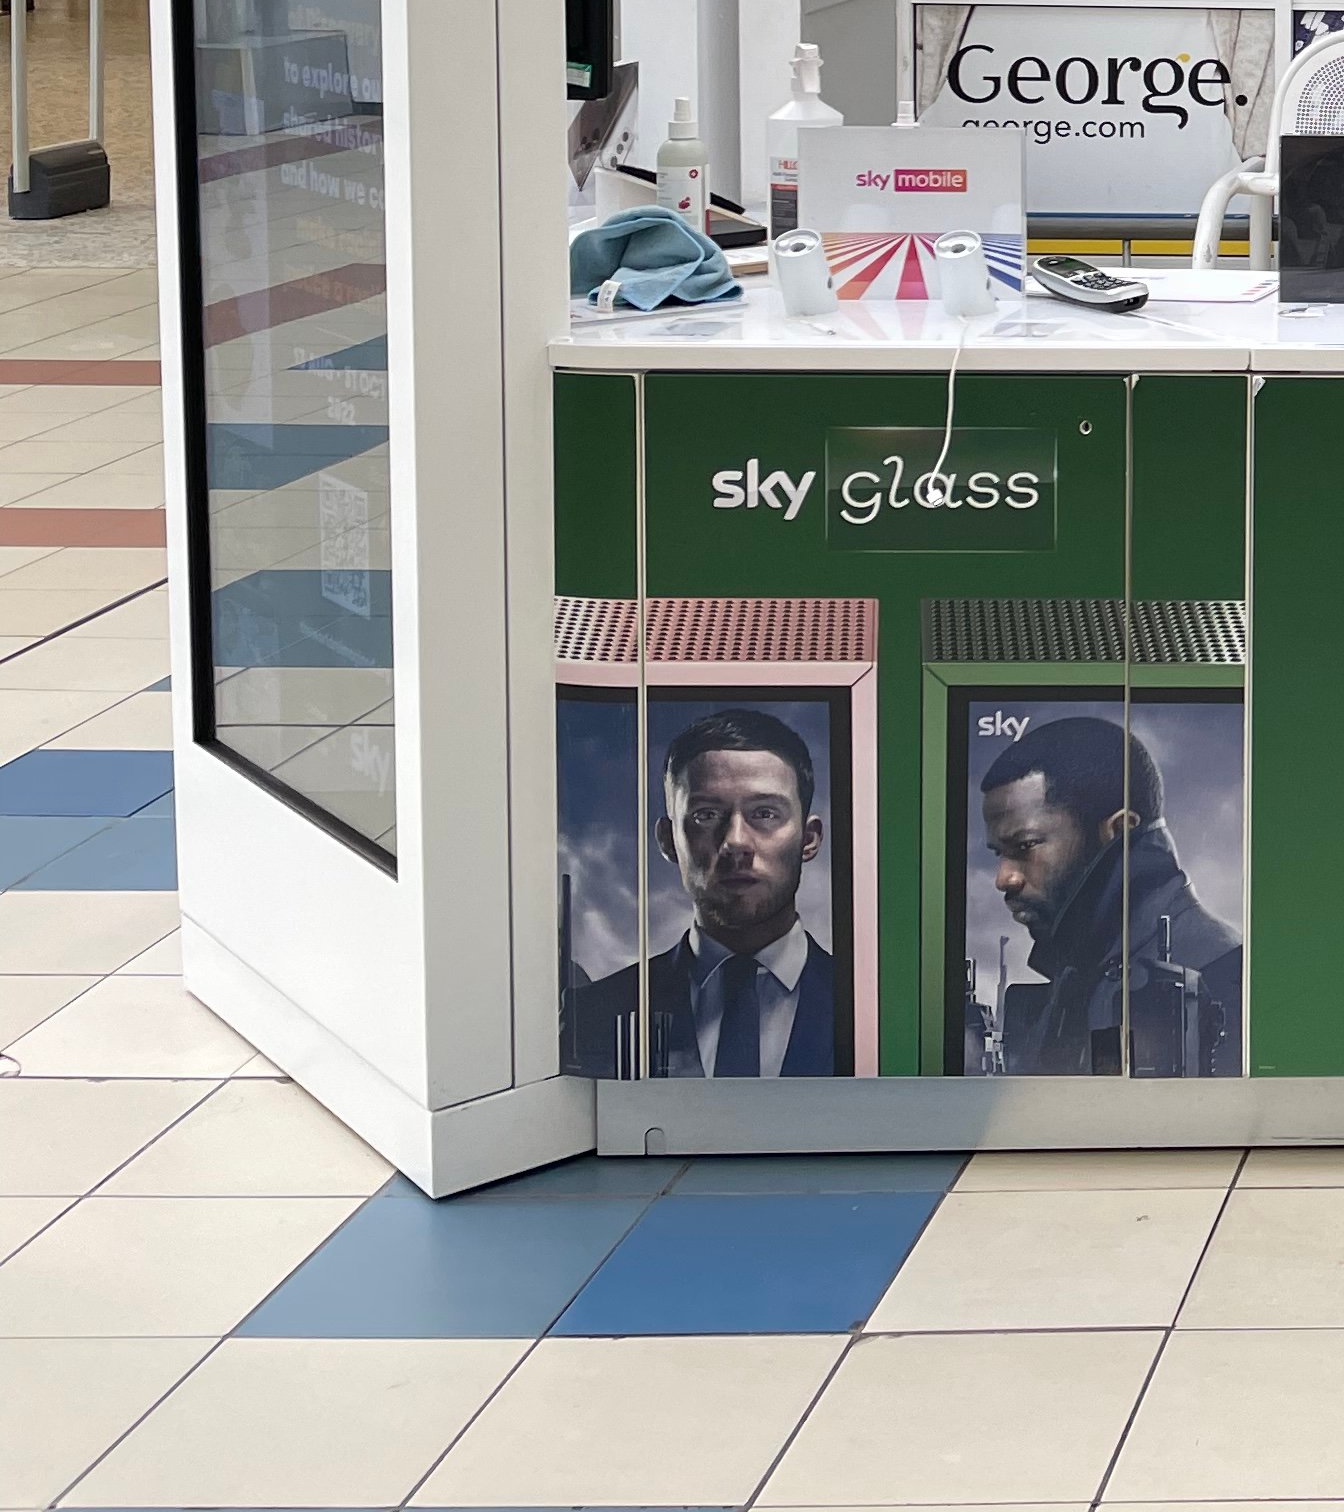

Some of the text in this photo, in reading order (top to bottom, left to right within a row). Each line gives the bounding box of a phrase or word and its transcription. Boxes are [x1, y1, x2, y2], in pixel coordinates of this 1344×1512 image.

[303, 61, 361, 99] explore
[856, 171, 963, 191] sky mobile
[711, 455, 1040, 525] sky glass
[978, 710, 1030, 741] sky
